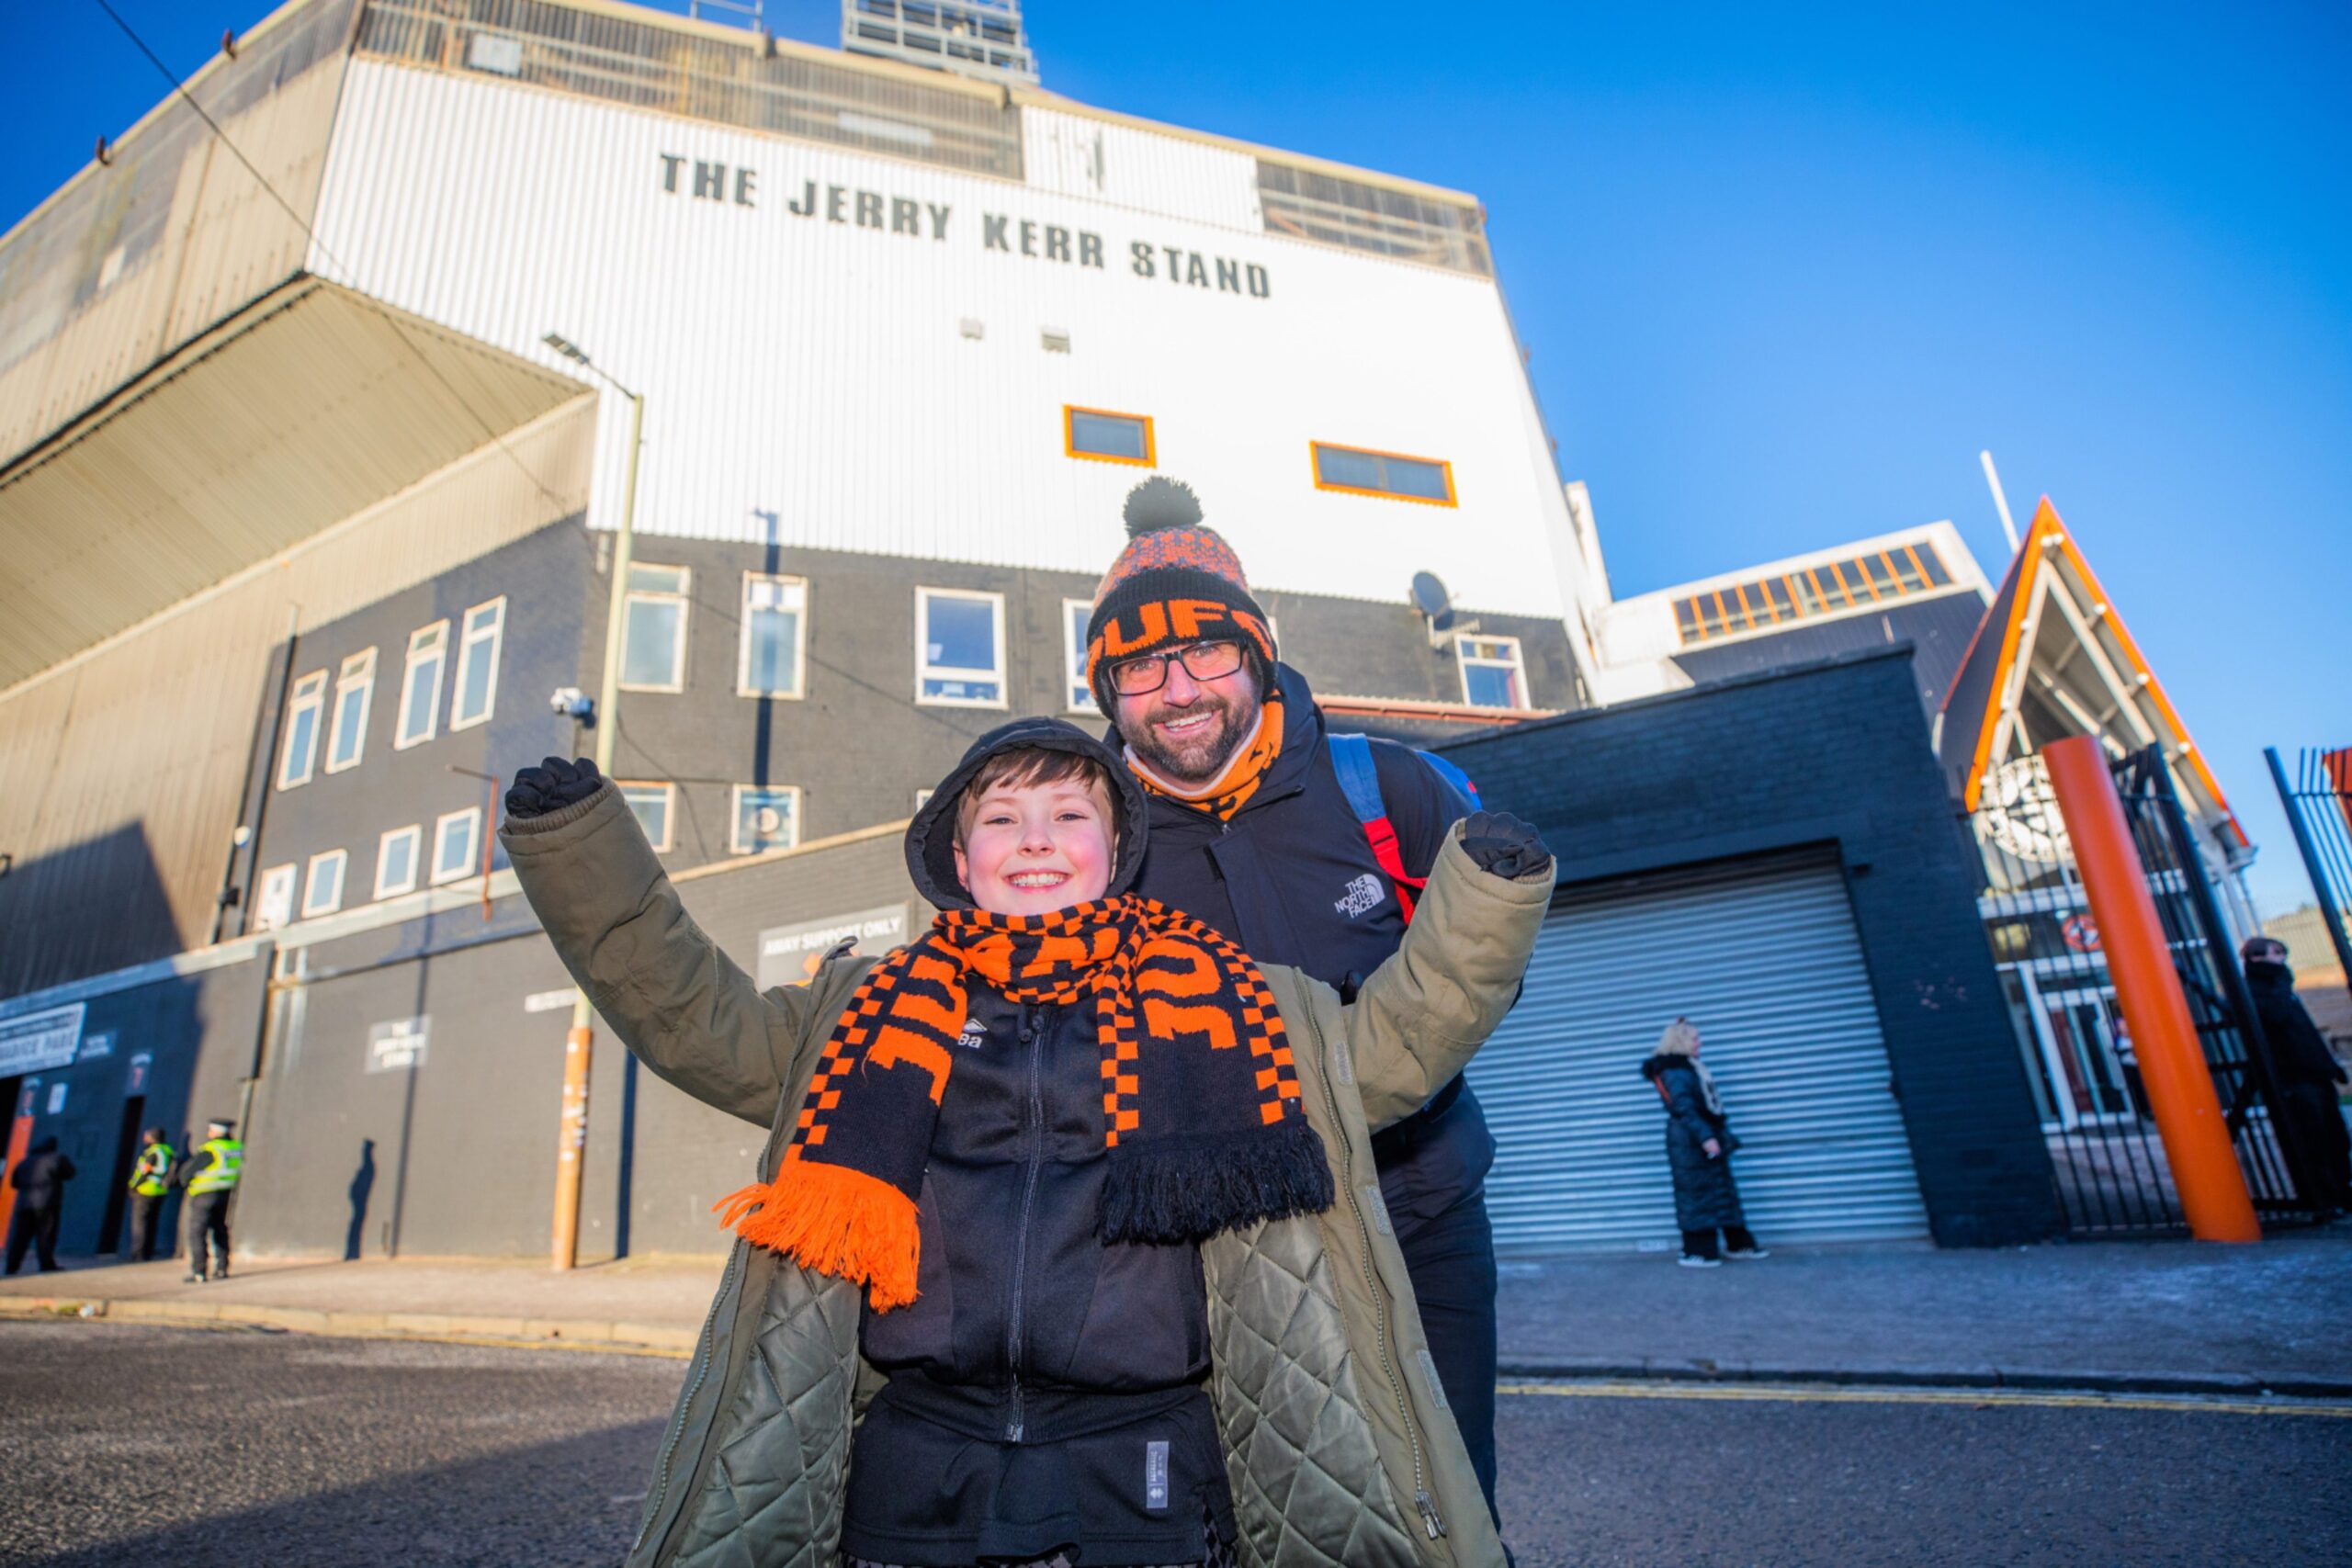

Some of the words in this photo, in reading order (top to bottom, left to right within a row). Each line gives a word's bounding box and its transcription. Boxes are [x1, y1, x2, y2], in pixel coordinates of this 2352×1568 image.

[659, 153, 758, 209] THE
[787, 181, 952, 241] JERRY
[983, 214, 1105, 269] KERR
[1130, 242, 1272, 299] STAND
[1345, 876, 1366, 894] THE
[1334, 886, 1370, 913] NORTH
[1348, 897, 1373, 919] FACE
[763, 935, 800, 956] AWAY
[801, 924, 862, 950] SUPPORT
[863, 917, 901, 938] ONLY
